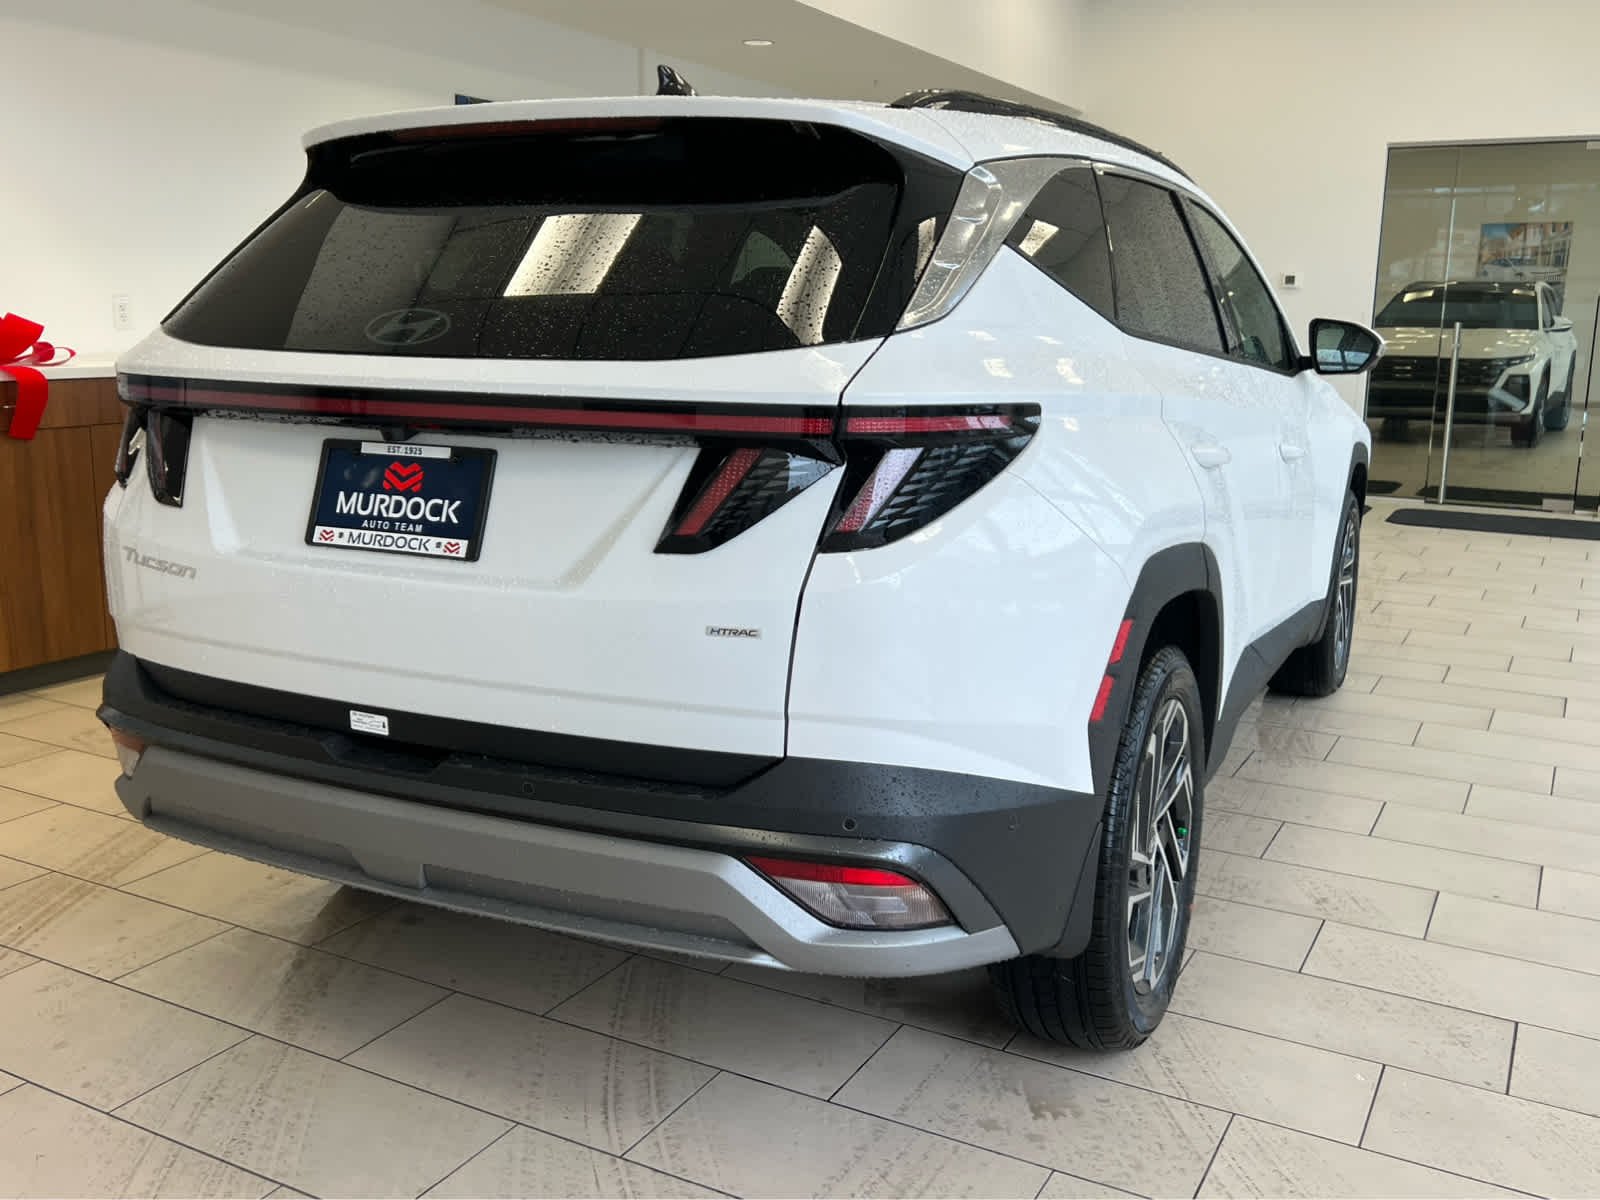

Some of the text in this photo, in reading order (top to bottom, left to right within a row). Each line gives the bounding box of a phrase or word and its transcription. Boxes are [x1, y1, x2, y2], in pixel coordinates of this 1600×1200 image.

[335, 490, 462, 524] MURDOCK
[361, 519, 423, 533] AUTO TEAM
[347, 531, 431, 551] MURDOCK
[709, 627, 759, 638] HTRAC
